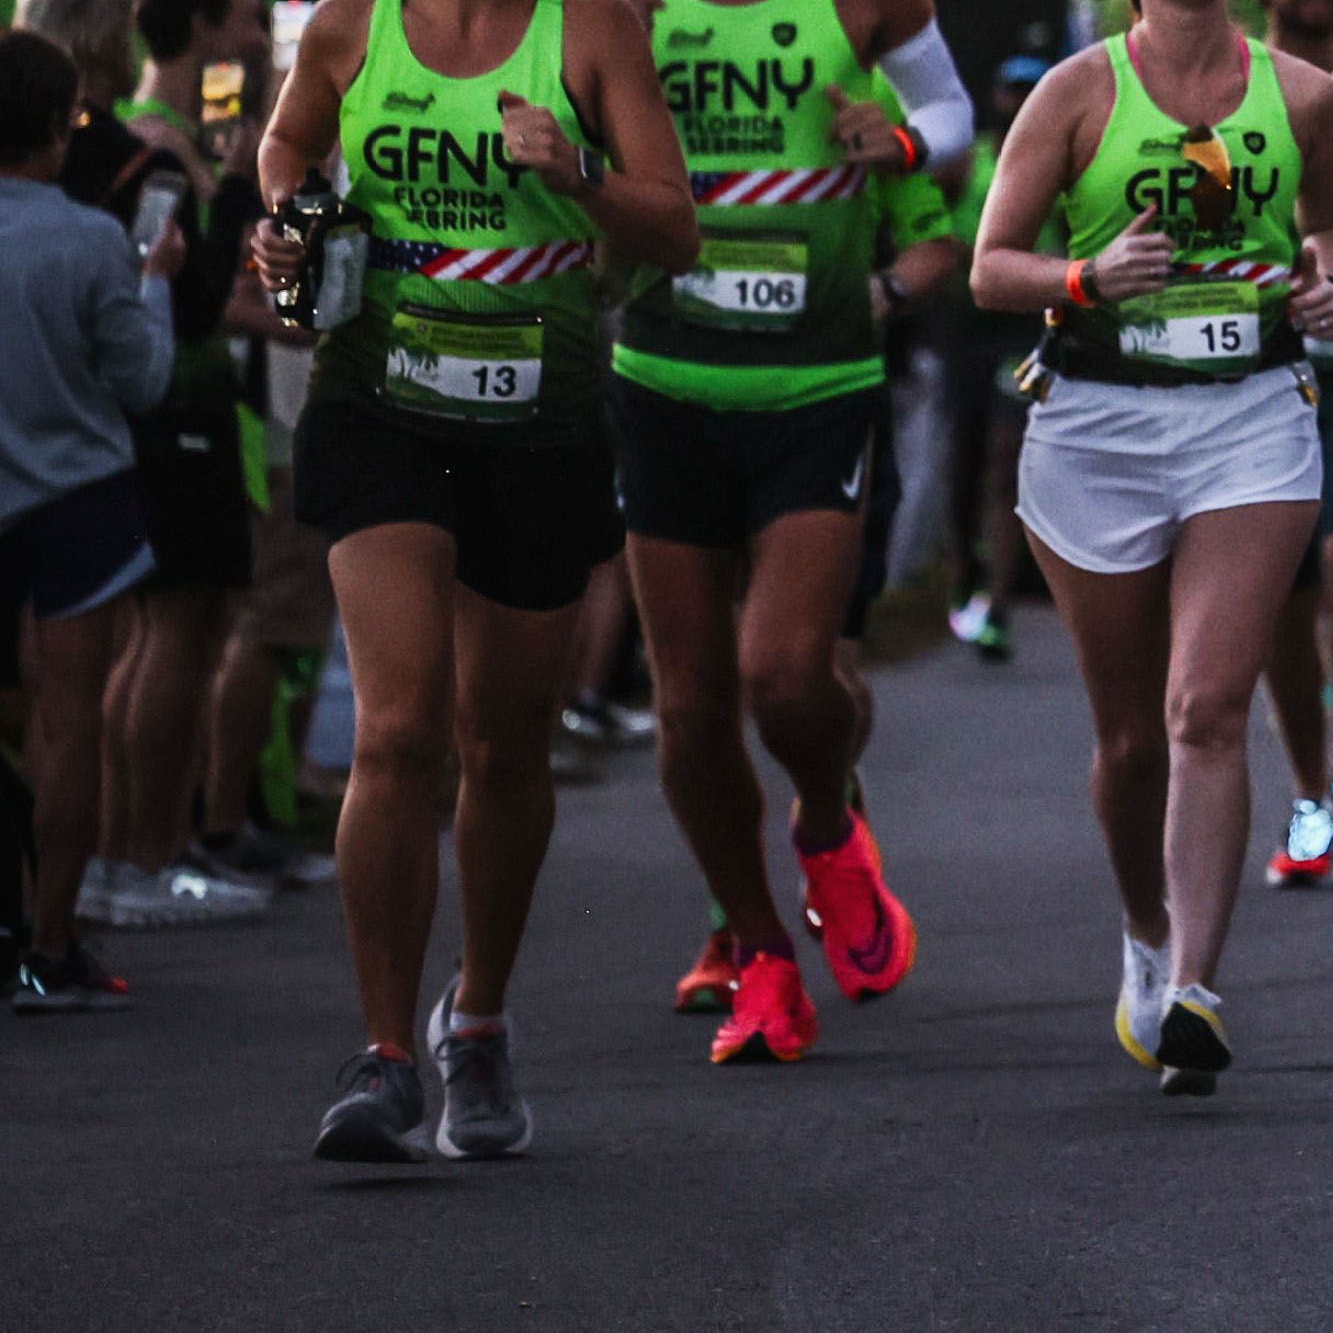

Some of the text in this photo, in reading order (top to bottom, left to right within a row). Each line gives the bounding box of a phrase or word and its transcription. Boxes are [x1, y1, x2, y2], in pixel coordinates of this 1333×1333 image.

[660, 58, 814, 111] GFNY
[395, 187, 504, 210] FLORIDA
[736, 278, 796, 308] 106
[1201, 320, 1241, 353] 15
[472, 366, 517, 397] 13
